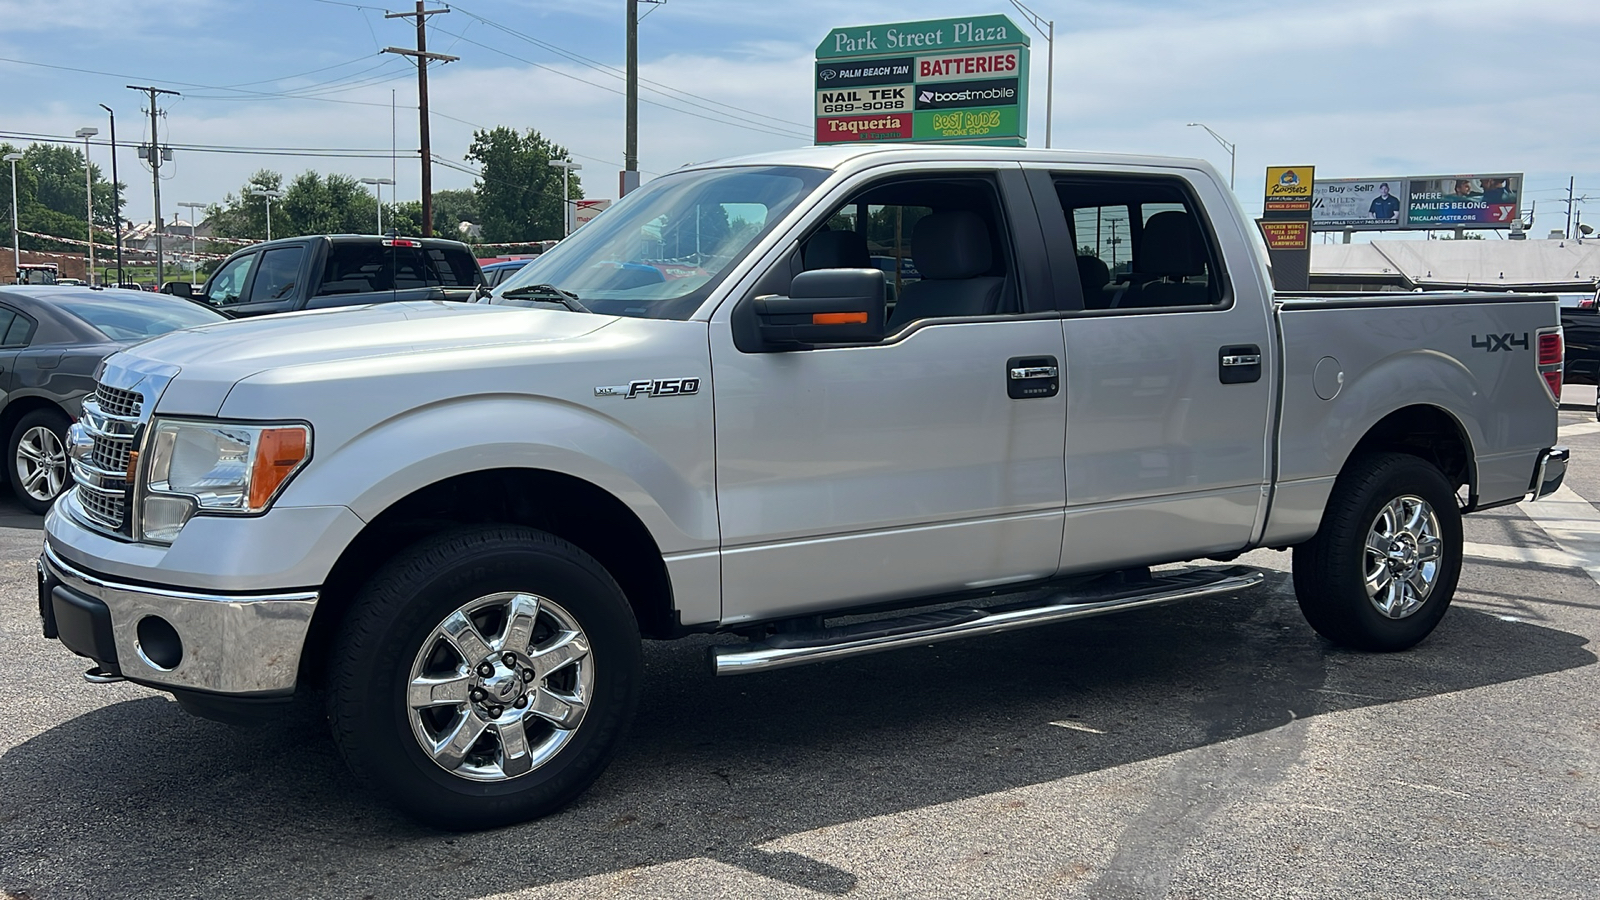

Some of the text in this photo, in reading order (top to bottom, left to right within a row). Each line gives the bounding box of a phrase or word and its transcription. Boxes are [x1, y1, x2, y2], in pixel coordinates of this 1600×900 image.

[834, 21, 1008, 52] Park Street Plaza
[839, 65, 909, 79] PALM BEACH TAN
[920, 54, 1016, 77] BATTERIES
[822, 88, 905, 103] NAIL TEK
[824, 100, 904, 113] 689-9088
[943, 127, 989, 136] SMOKE SHOP
[1271, 184, 1307, 195] Roosters
[1354, 184, 1374, 192] Sell?
[1411, 192, 1441, 200] WHERE
[1410, 201, 1489, 210] FAMILIES BELONG.
[598, 377, 701, 399] XLT F-150
